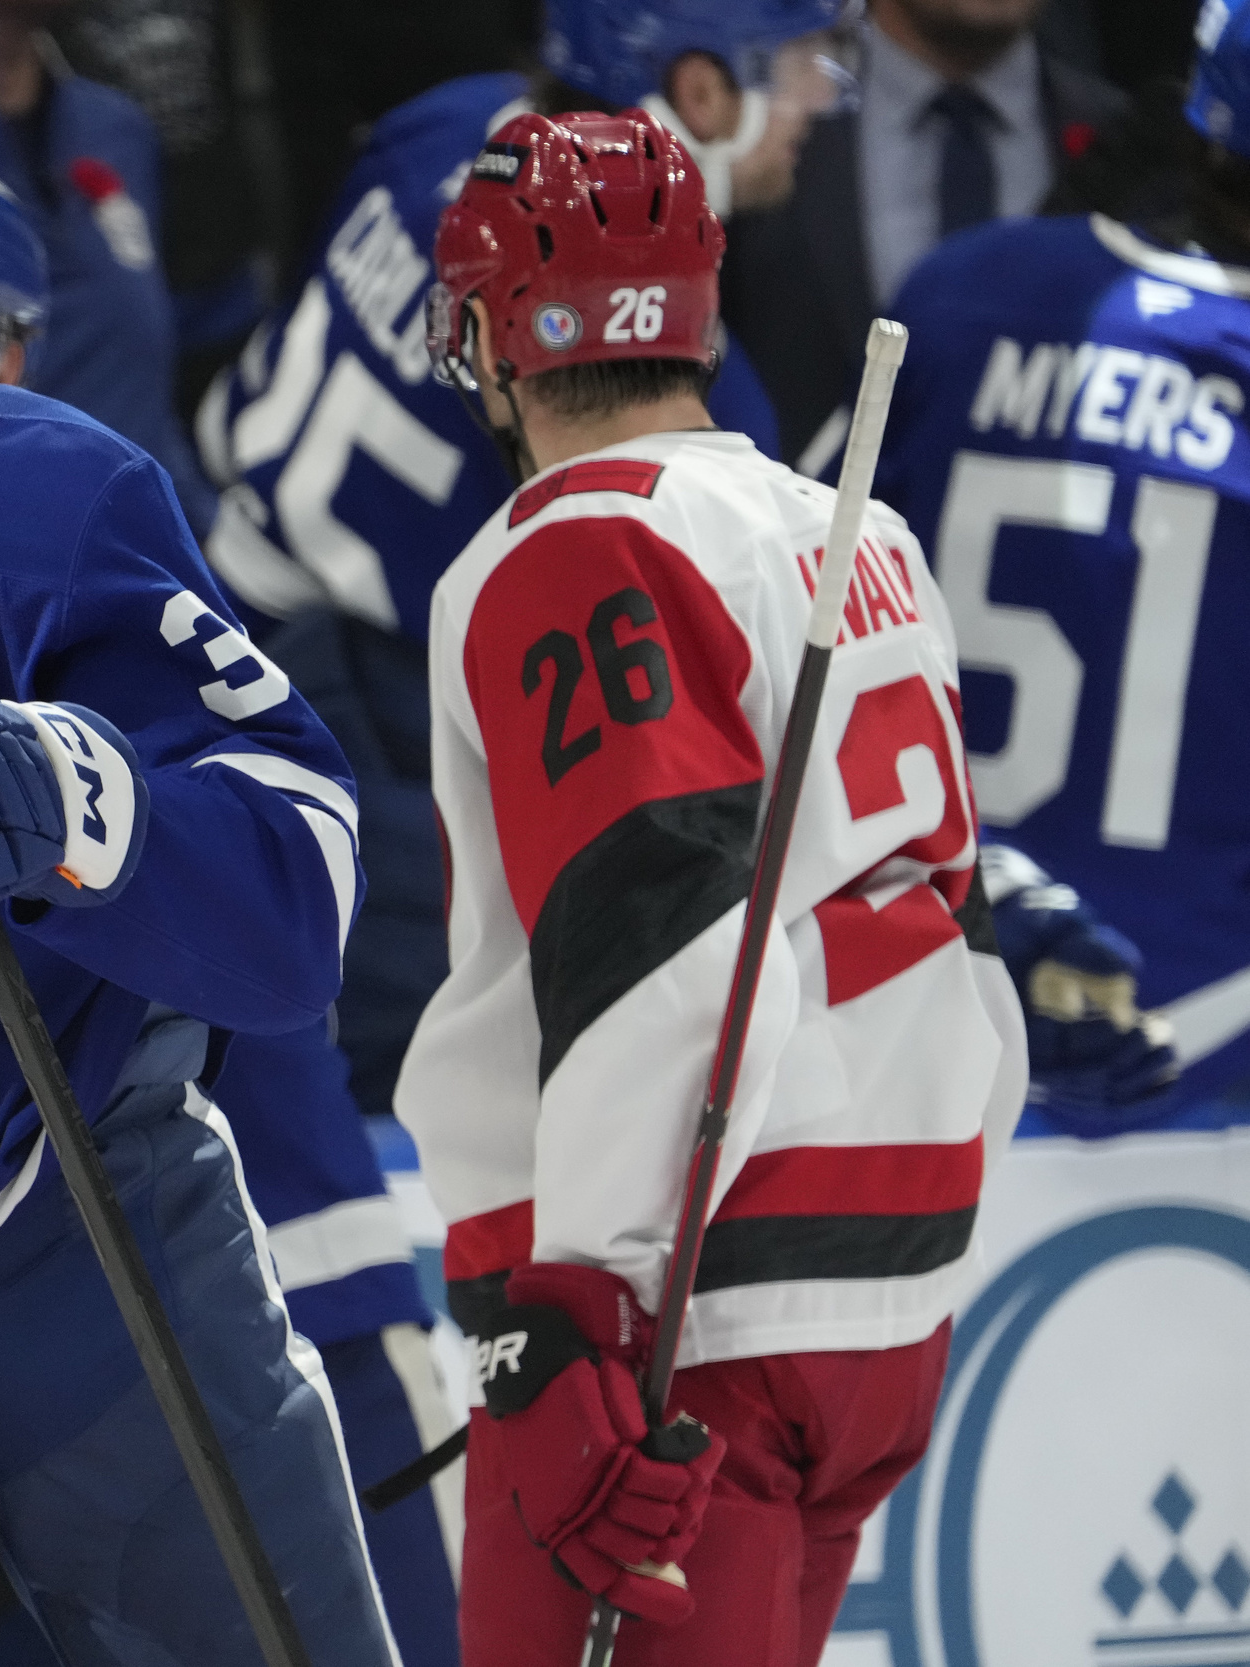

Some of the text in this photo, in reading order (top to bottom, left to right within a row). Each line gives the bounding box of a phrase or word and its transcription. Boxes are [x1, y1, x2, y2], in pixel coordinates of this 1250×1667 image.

[603, 285, 667, 343] 26
[969, 336, 1246, 472] MYERS
[522, 587, 674, 788] 26
[936, 448, 1220, 851] 51
[34, 703, 108, 846] CM
